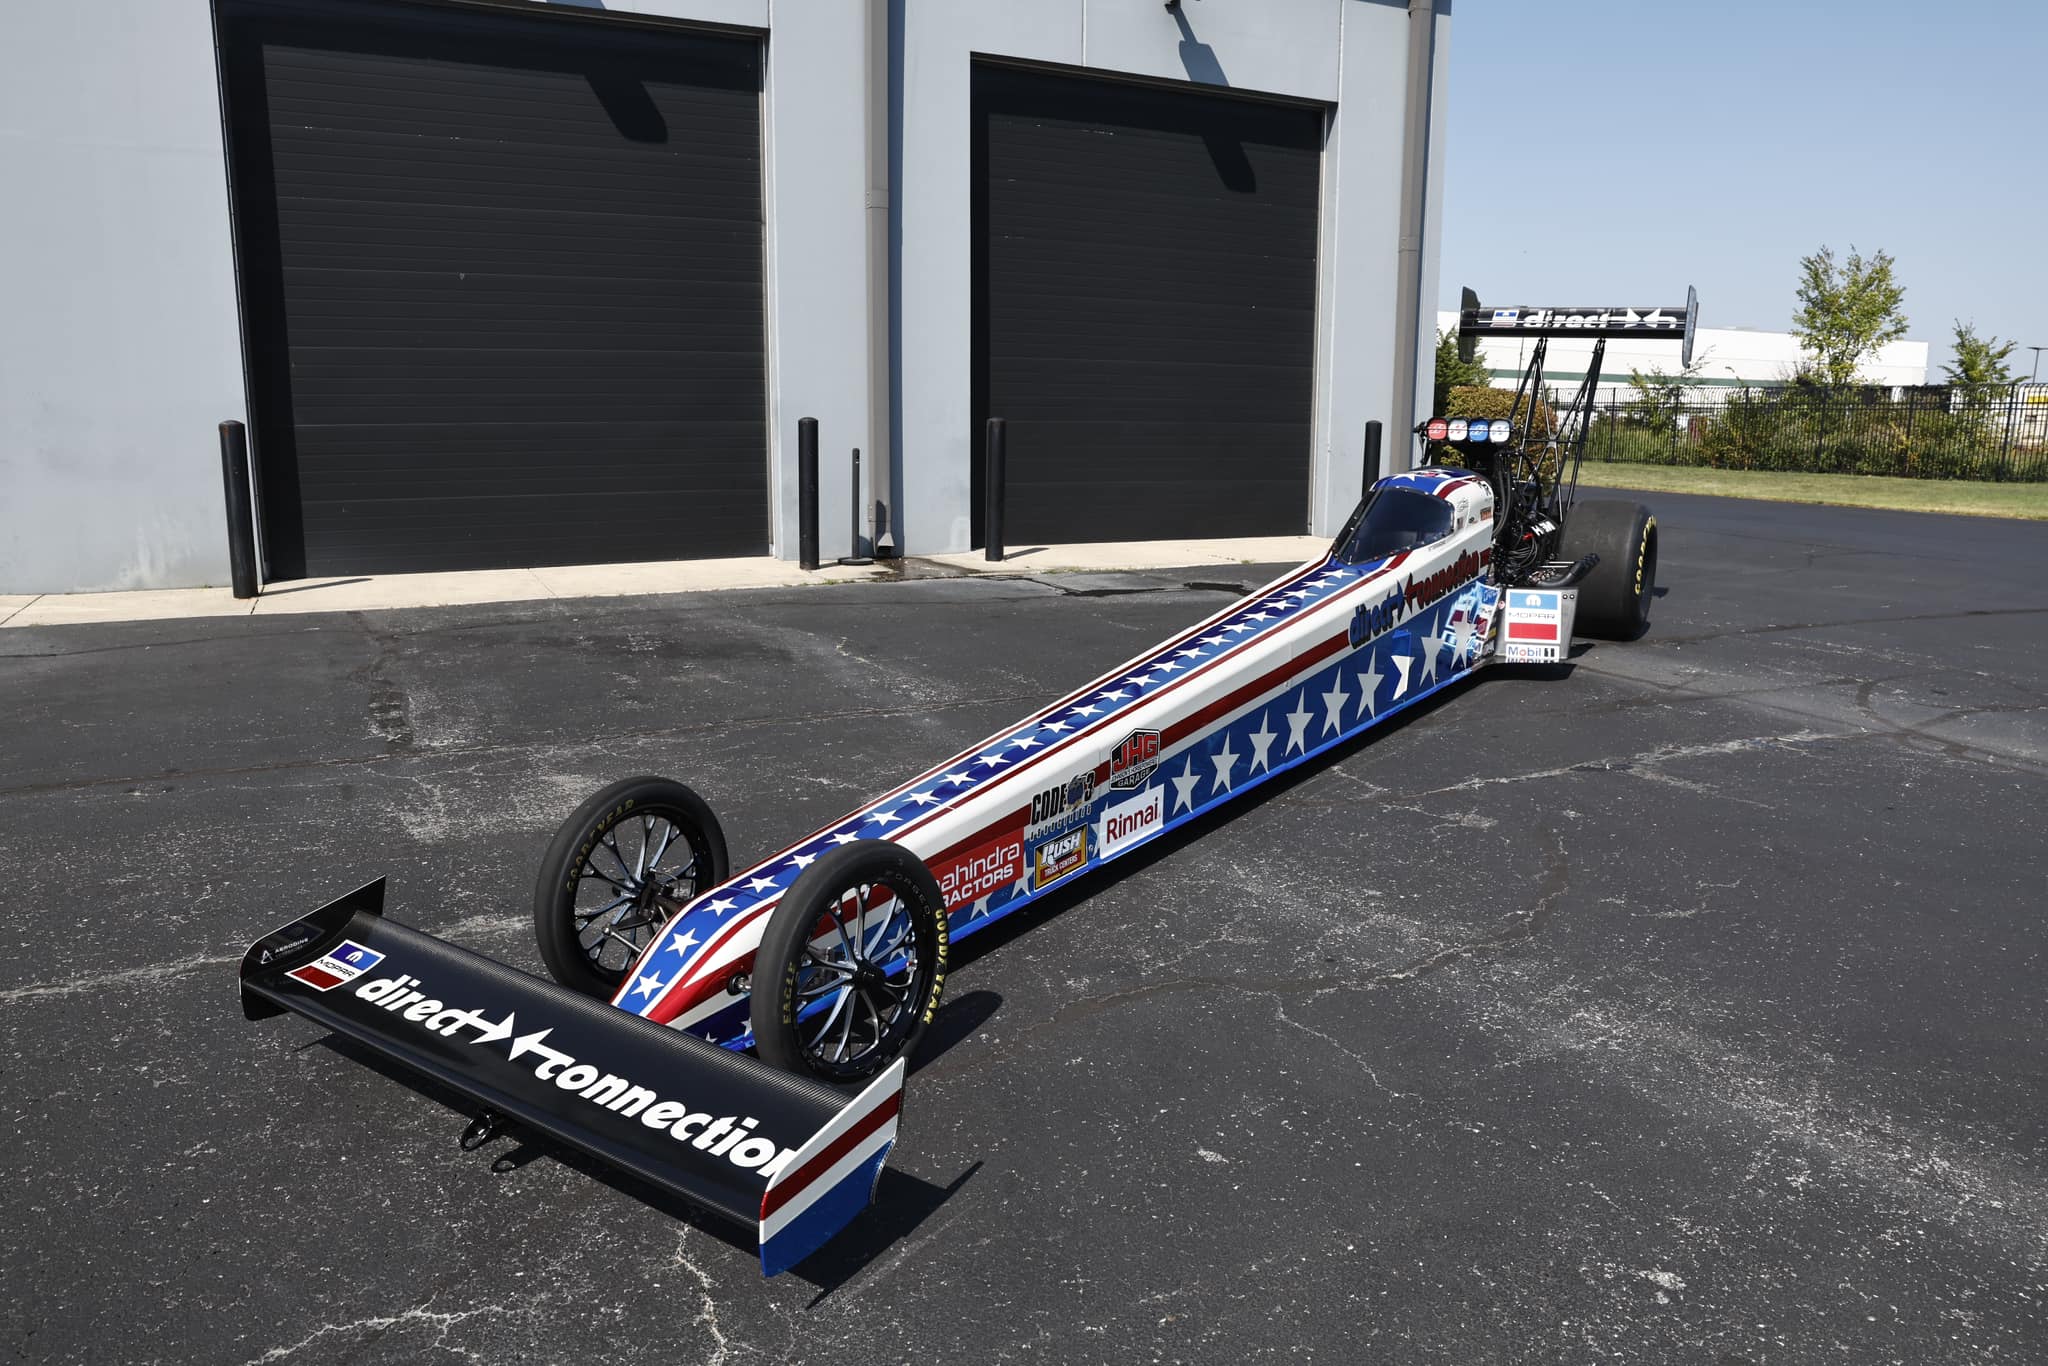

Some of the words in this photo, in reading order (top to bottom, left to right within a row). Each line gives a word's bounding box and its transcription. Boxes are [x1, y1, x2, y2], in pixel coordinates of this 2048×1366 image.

[1523, 310, 1612, 328] direct
[1349, 589, 1396, 649] direct
[1508, 646, 1541, 657] Mobil
[1113, 734, 1157, 772] JHG
[1118, 768, 1151, 786] GARAGE
[1031, 783, 1067, 825] CODE
[1084, 771, 1095, 801] 3
[1107, 796, 1158, 844] Rinnai
[566, 799, 635, 891] GOODYEAR
[936, 843, 1020, 892] ahindra
[943, 863, 1014, 907] RACTORS
[318, 959, 356, 977] MOPAR
[923, 908, 949, 1025] GOODYEAR
[355, 974, 485, 1037] direct
[534, 1052, 798, 1178] connection
